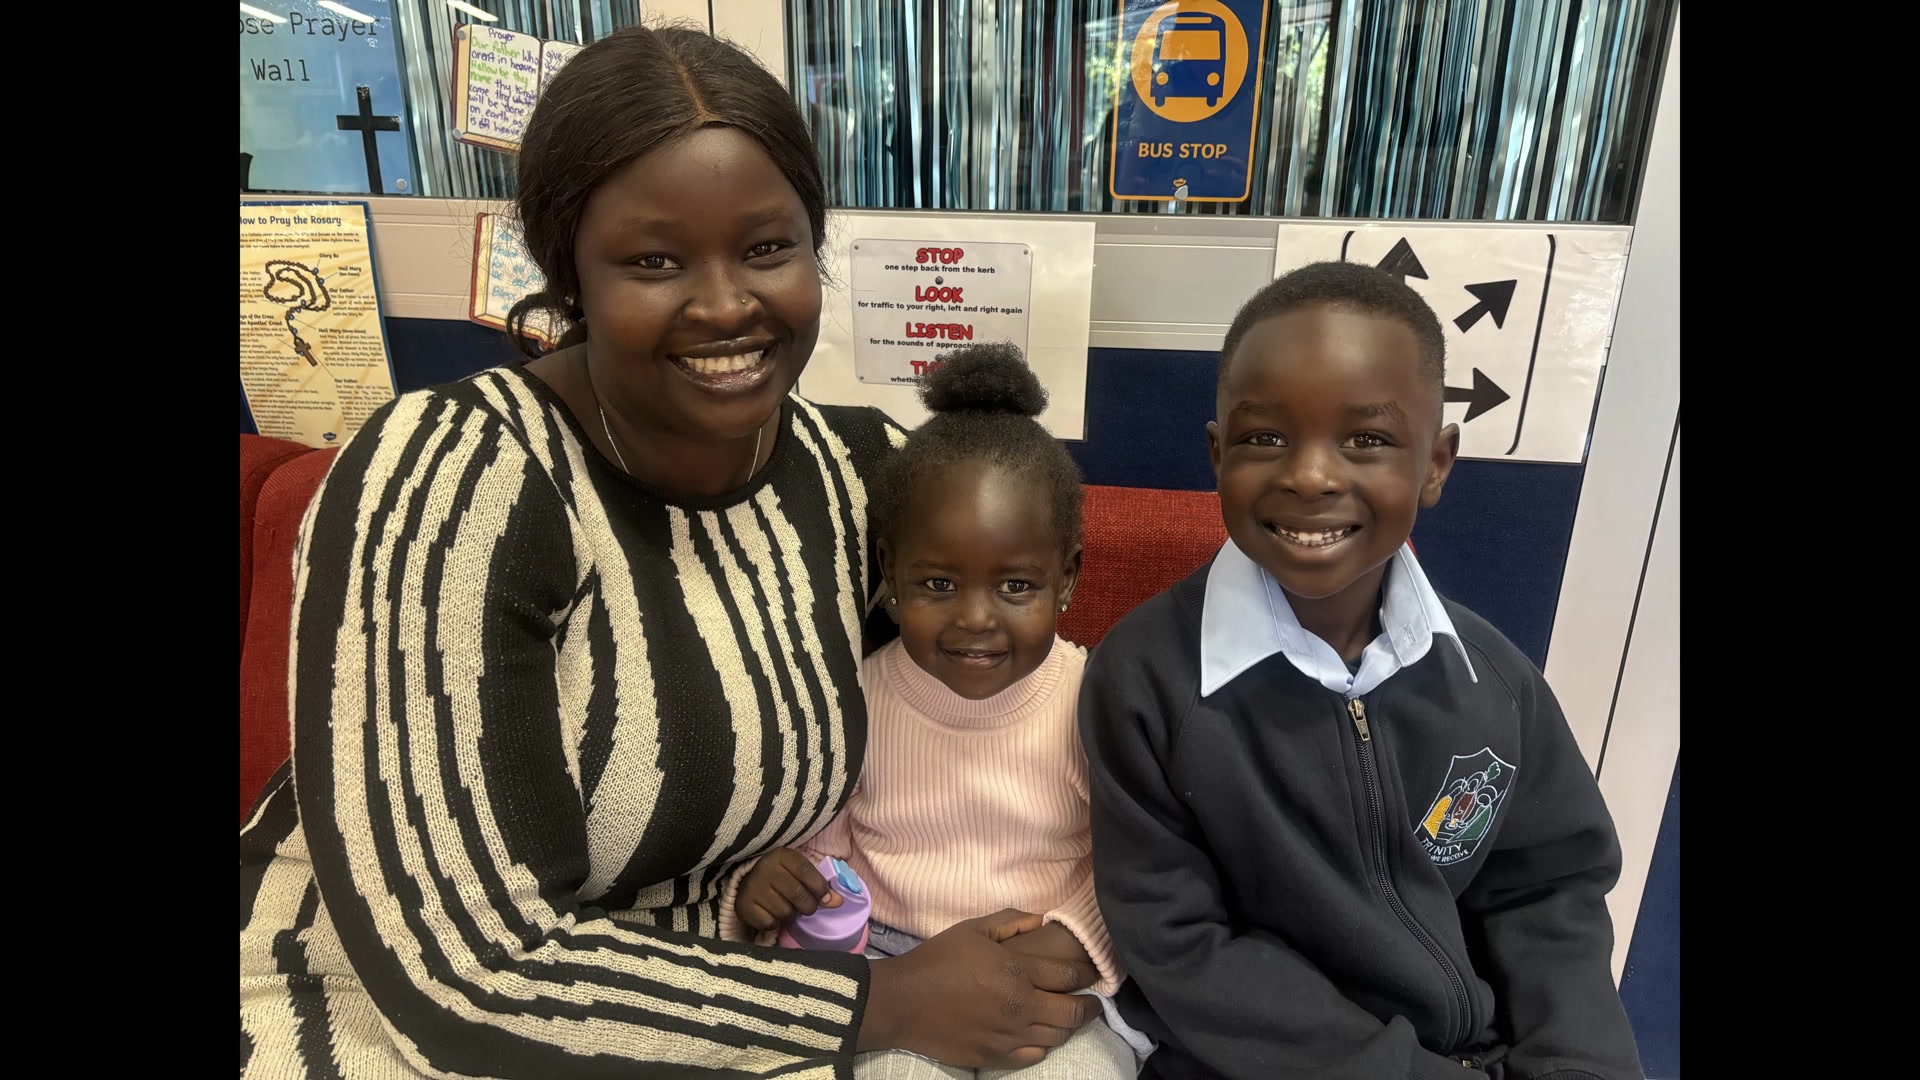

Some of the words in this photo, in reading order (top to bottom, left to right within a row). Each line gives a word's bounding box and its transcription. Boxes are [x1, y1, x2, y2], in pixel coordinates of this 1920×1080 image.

[289, 12, 380, 42] Prayer
[472, 36, 488, 49] Our
[488, 27, 515, 45] Prayer
[497, 55, 507, 64] in
[250, 58, 310, 82] Wall
[469, 94, 484, 104] will
[488, 97, 498, 109] be
[470, 105, 481, 114] on
[485, 109, 509, 122] earth
[470, 114, 477, 125] is
[1138, 142, 1173, 158] BUS
[1179, 143, 1228, 159] STOP
[258, 216, 267, 224] to
[269, 215, 291, 227] Pray
[293, 215, 308, 224] the
[310, 215, 342, 227] Rosary
[915, 247, 965, 265] STOP
[901, 265, 918, 273] step
[941, 265, 960, 273] from
[977, 266, 995, 274] kerb
[915, 285, 964, 304] LOOK
[870, 301, 894, 309] traffic
[925, 303, 946, 312] right,
[948, 304, 961, 312] left
[980, 306, 998, 314] right
[1000, 307, 1023, 315] again
[905, 322, 973, 340] LISTEN
[882, 338, 895, 346] the
[897, 339, 923, 347] sounds
